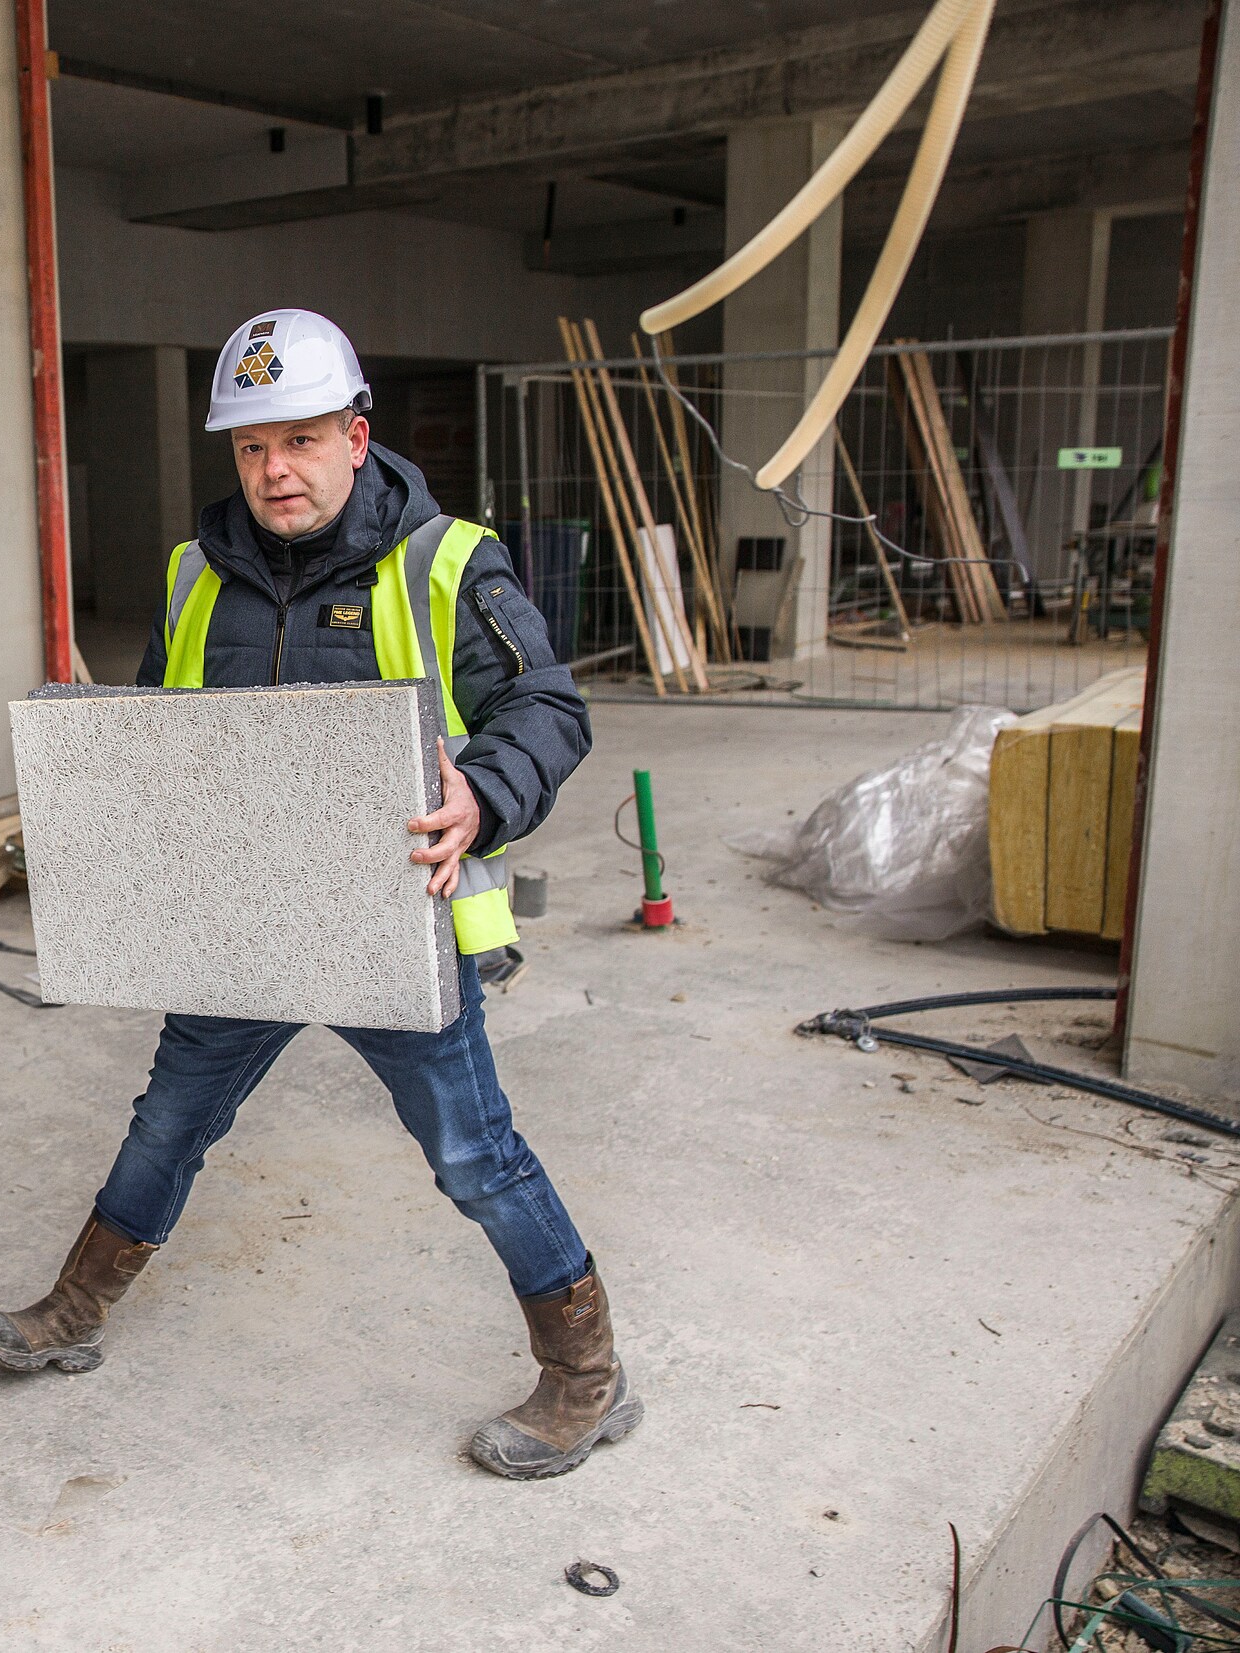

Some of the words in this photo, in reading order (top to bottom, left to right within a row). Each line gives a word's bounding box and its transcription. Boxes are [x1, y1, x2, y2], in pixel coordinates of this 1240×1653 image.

[488, 617, 502, 634] TESTED
[505, 640, 517, 651] HIGH
[515, 651, 523, 674] ALTITUDE
